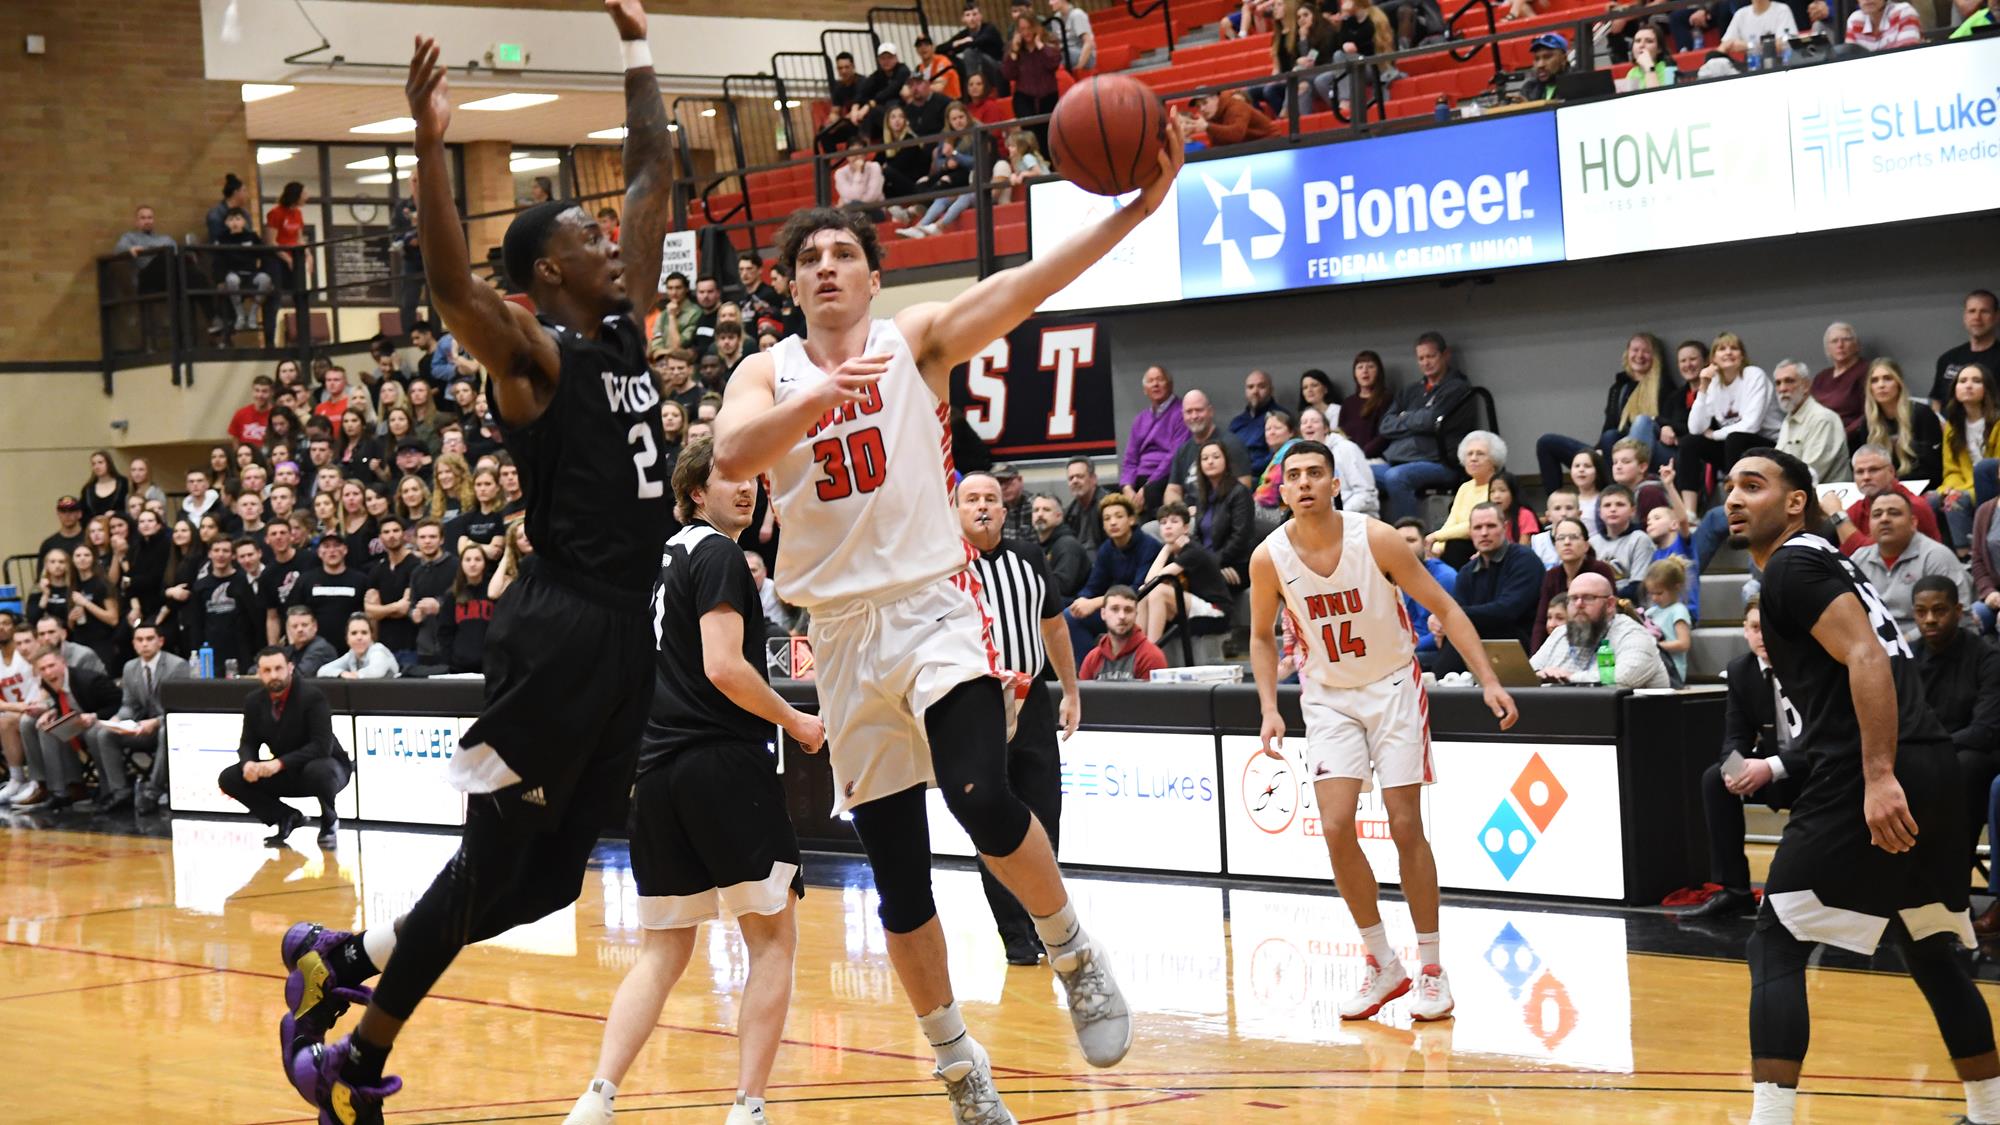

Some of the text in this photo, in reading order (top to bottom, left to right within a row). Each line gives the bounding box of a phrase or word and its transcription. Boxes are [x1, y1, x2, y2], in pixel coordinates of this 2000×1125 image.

[1871, 102, 1904, 141] St
[1580, 122, 1715, 193] HOME
[1872, 151, 1933, 173] Sports
[1303, 169, 1530, 244] Pioneer
[662, 261, 694, 273] ESERVED
[663, 249, 691, 261] TUDENT
[1308, 235, 1533, 279] FEDERAL CREDIT UNION
[628, 421, 664, 500] 2
[812, 426, 887, 502] 30
[1304, 587, 1364, 621] NNU
[1322, 620, 1367, 663] 14
[1136, 766, 1213, 802] Lukes
[1362, 822, 1392, 839] UNI
